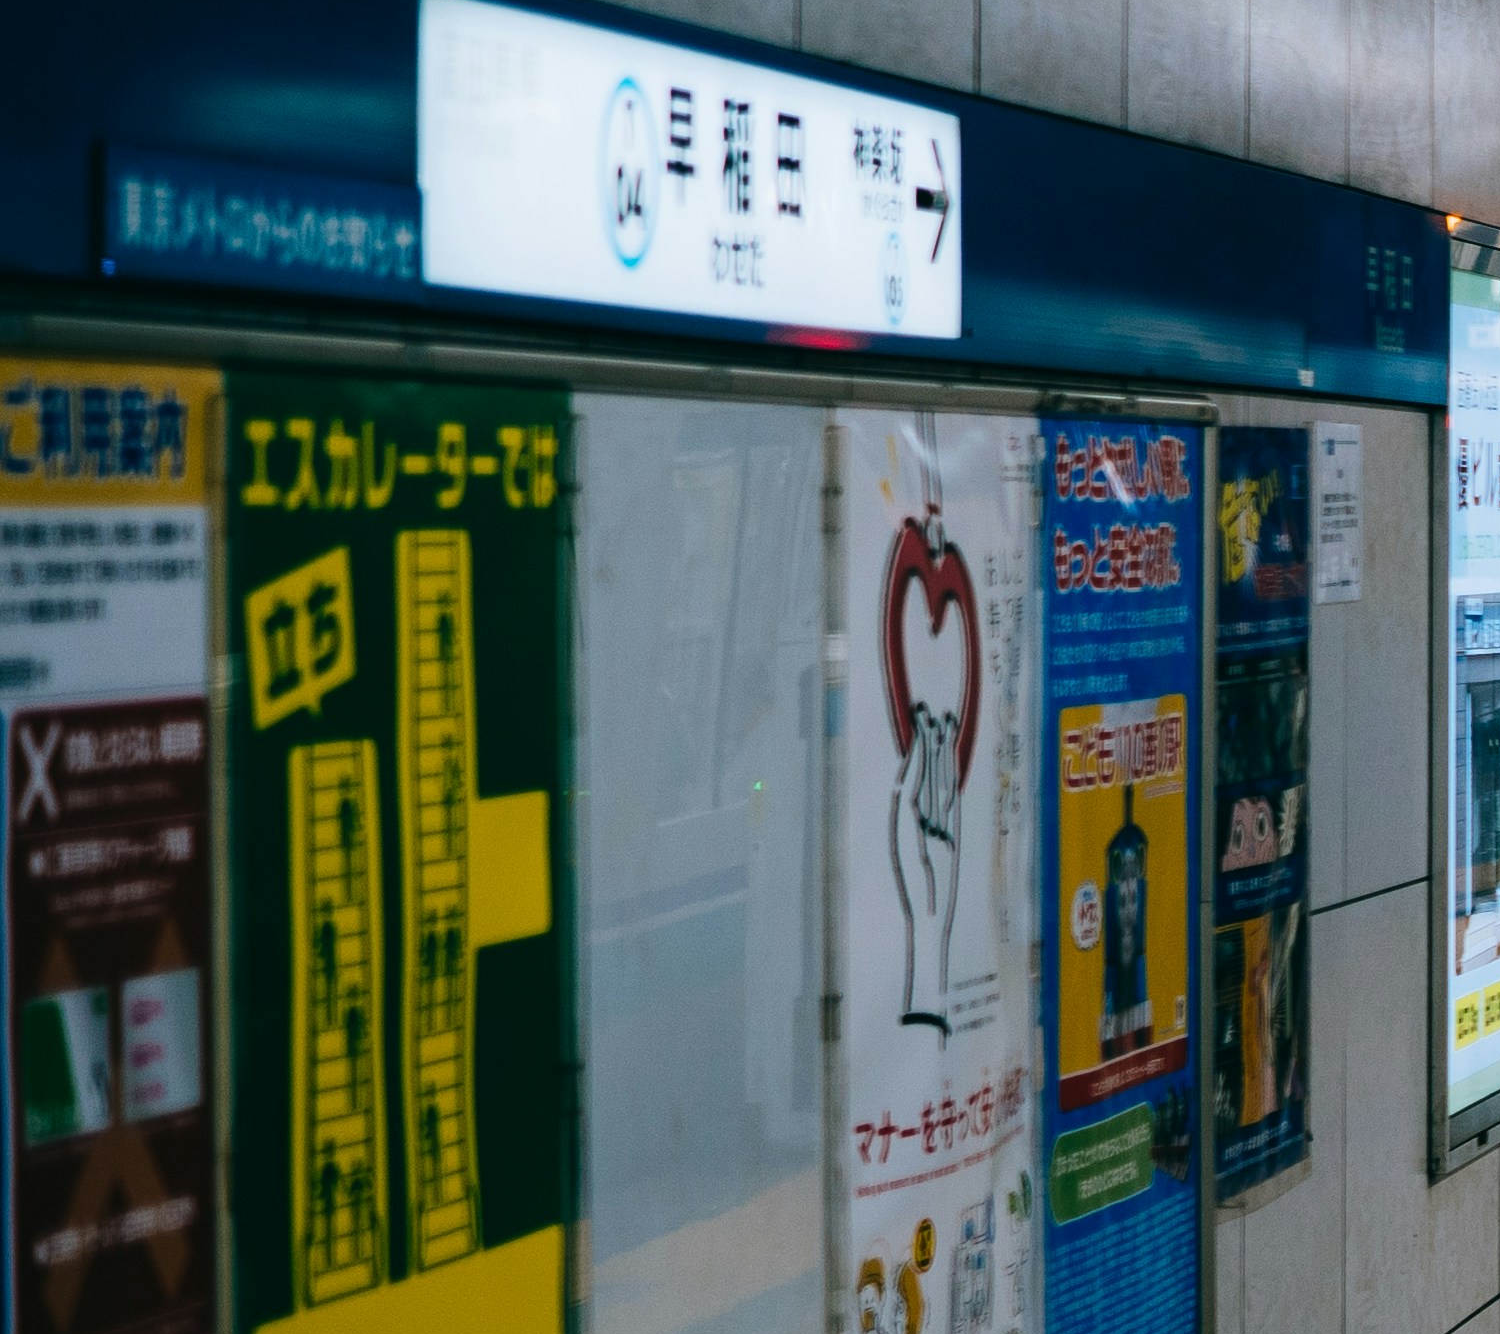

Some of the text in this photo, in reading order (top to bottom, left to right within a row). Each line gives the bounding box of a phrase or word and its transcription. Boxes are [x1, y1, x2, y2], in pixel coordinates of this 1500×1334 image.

[664, 85, 806, 220] 早稲田
[852, 119, 906, 186] 神楽坂
[709, 229, 767, 290] わせだ
[242, 419, 556, 509] エスカレーターでは
[264, 575, 340, 703] 立ち
